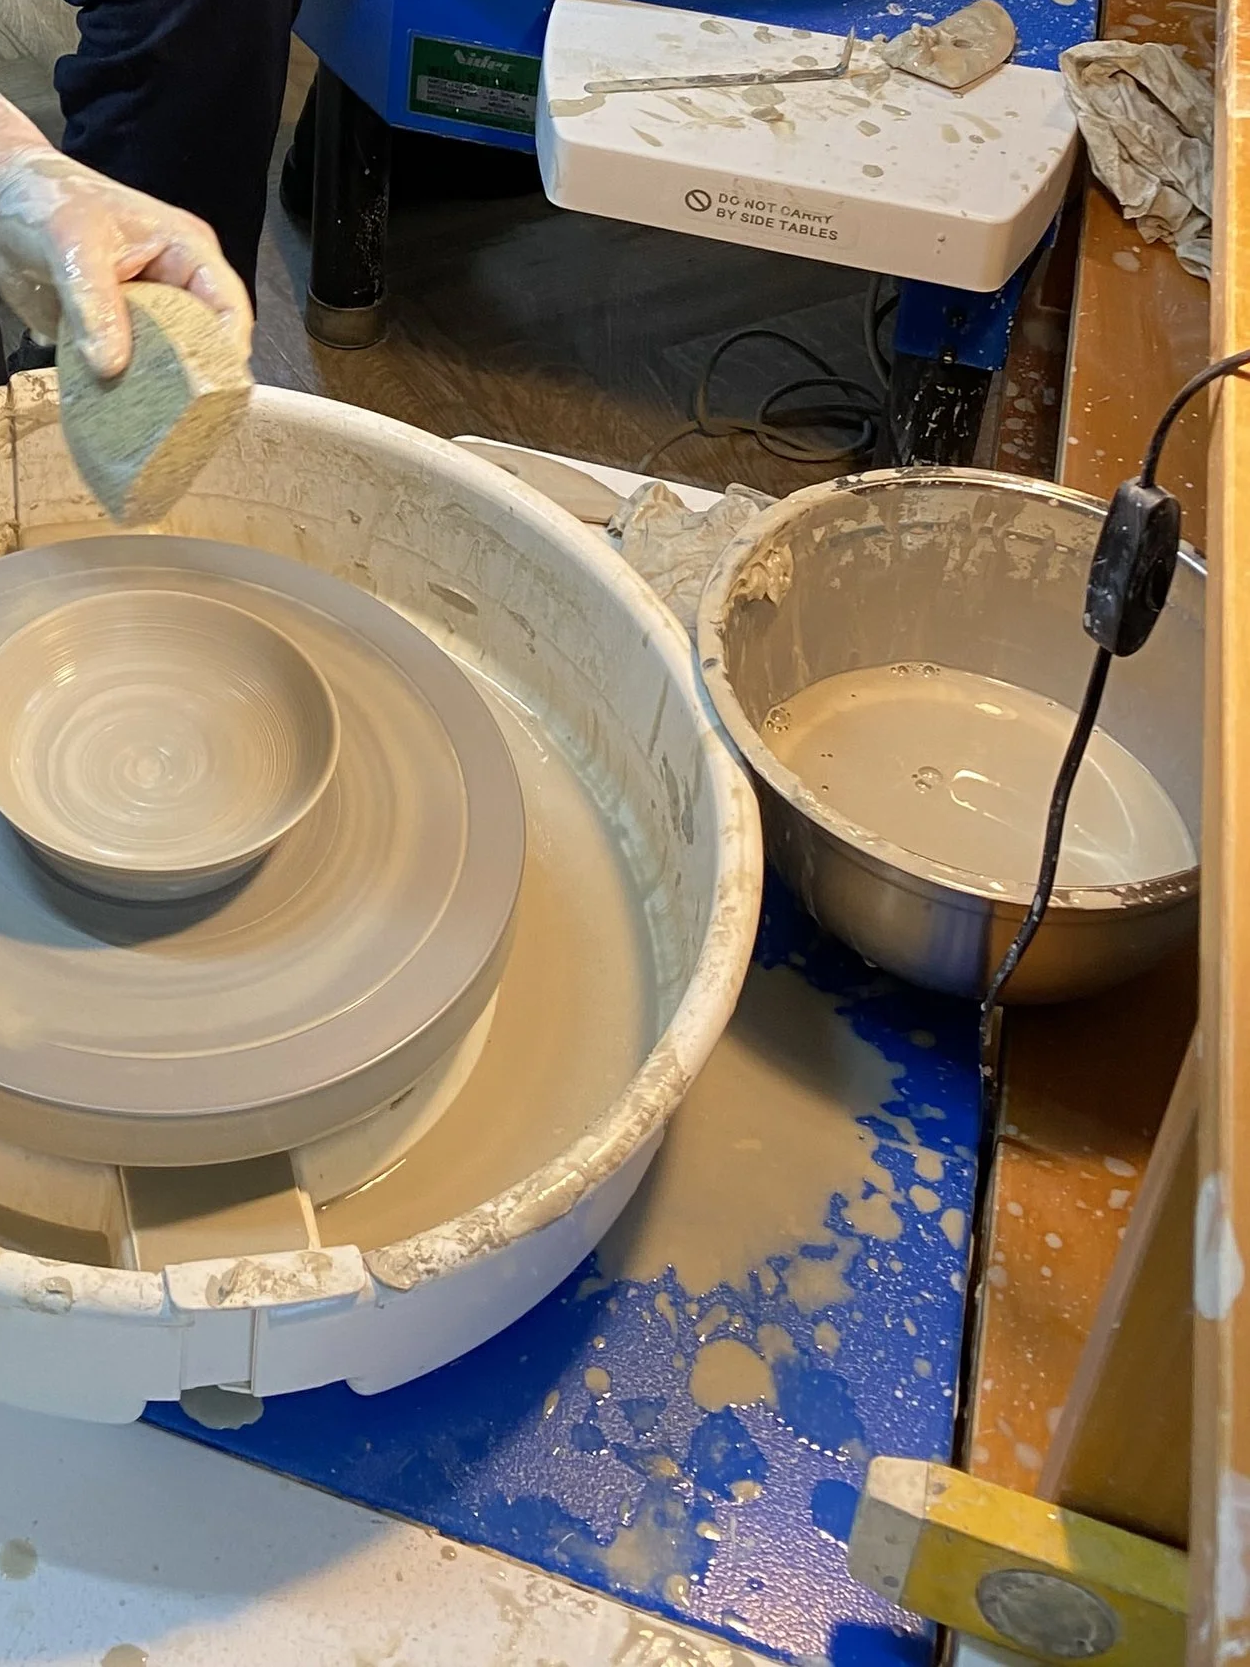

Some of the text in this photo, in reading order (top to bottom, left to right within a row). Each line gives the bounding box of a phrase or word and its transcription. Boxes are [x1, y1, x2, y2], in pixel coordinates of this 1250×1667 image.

[716, 207, 839, 241] BY SIDE TABLES
[718, 192, 834, 226] DO NOT CARRY
